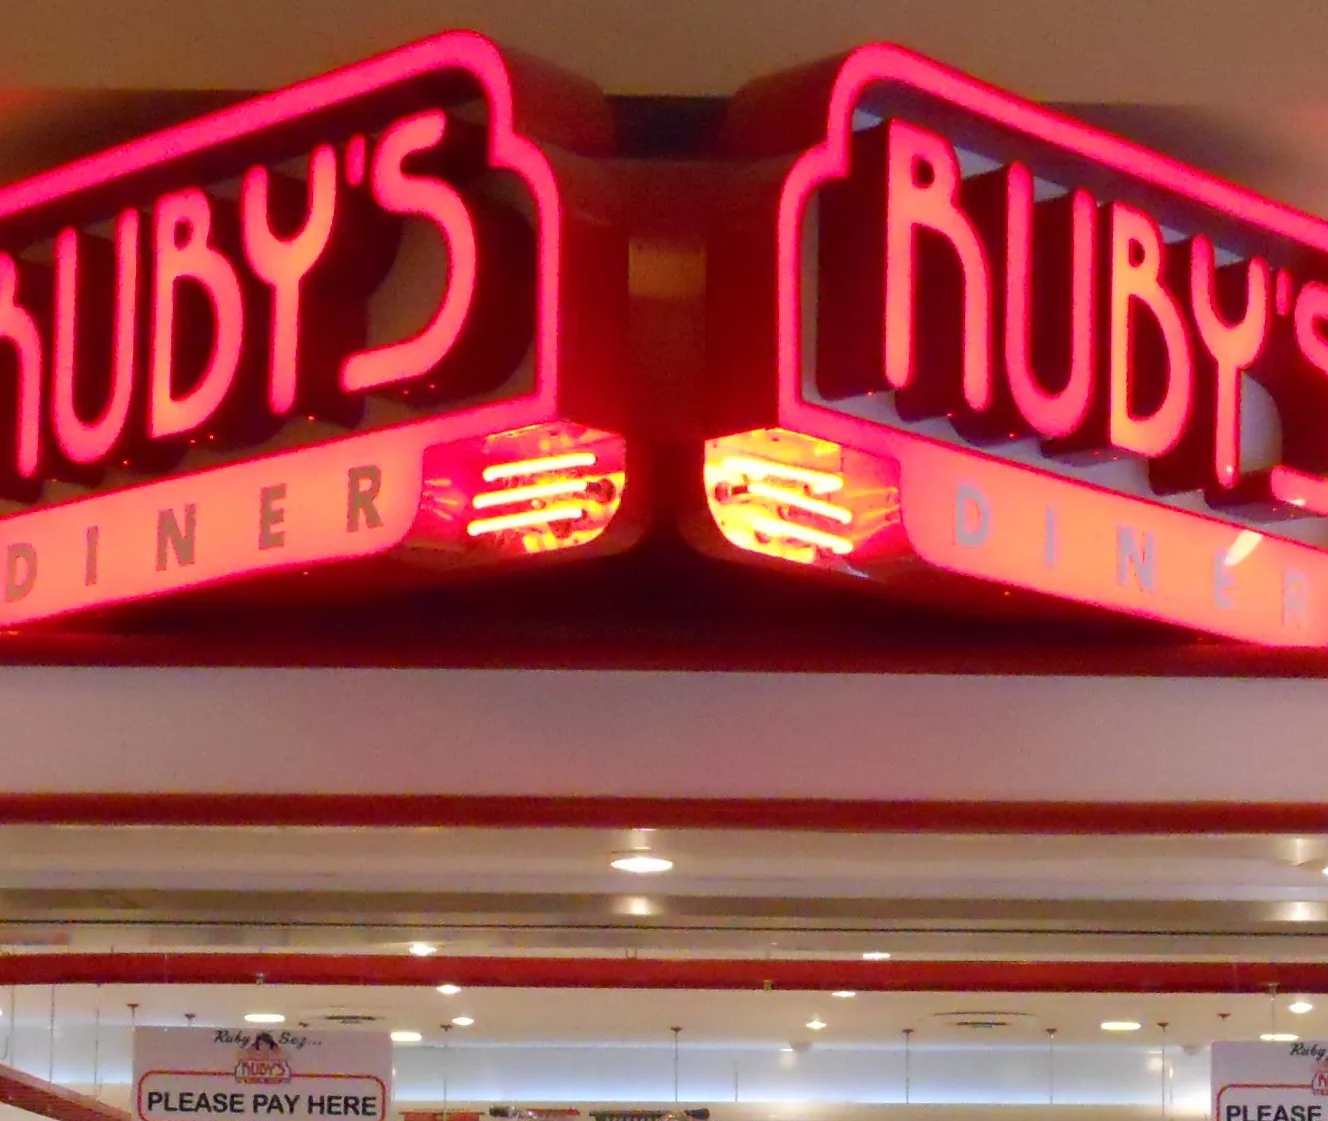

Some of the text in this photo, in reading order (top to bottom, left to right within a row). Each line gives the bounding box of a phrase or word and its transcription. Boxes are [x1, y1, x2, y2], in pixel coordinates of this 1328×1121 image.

[4, 463, 384, 603] DINER
[953, 483, 1314, 628] DINER
[214, 1030, 251, 1046] Ruby
[1289, 1043, 1327, 1060] Ruby
[147, 1091, 378, 1116] PLEASE PAY HERE
